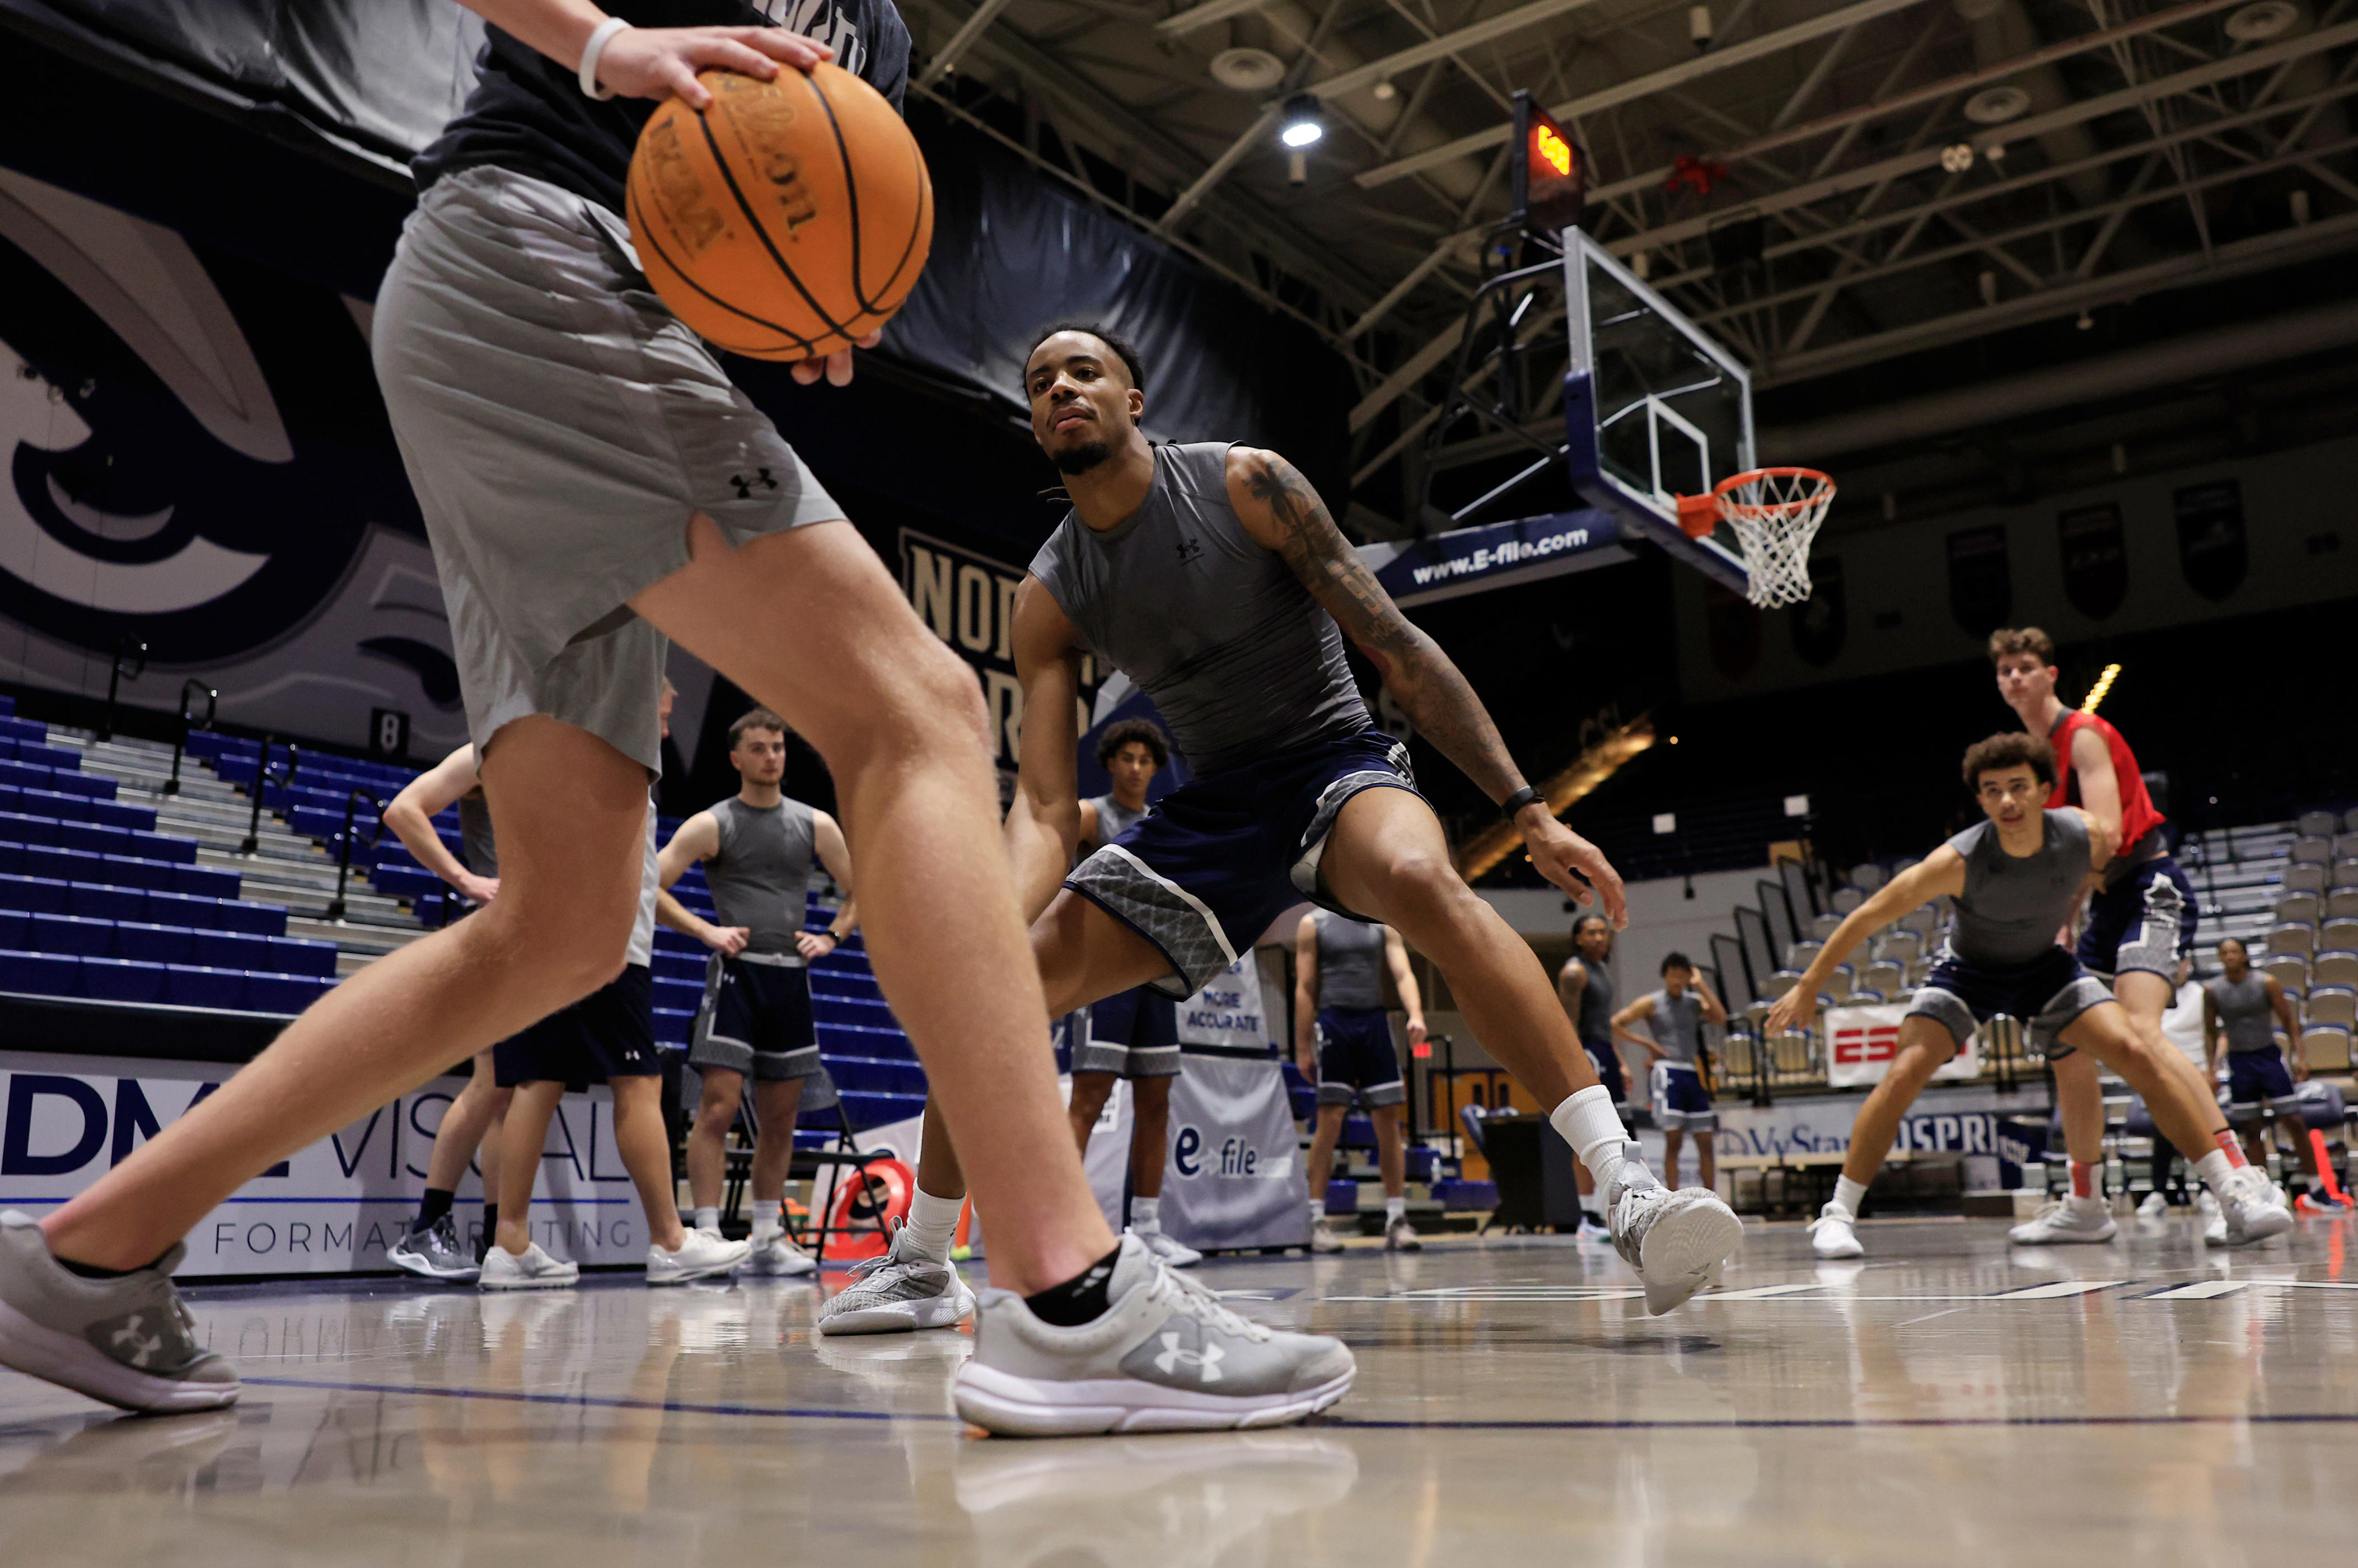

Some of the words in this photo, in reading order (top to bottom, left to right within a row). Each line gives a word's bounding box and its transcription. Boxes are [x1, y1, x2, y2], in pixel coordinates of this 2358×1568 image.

[1412, 528, 1589, 584] www.E-file.com
[380, 714, 400, 751] 8
[1203, 989, 1241, 1009] MORE
[1187, 1011, 1260, 1033] ACCURATE
[330, 1092, 632, 1182] VISAL
